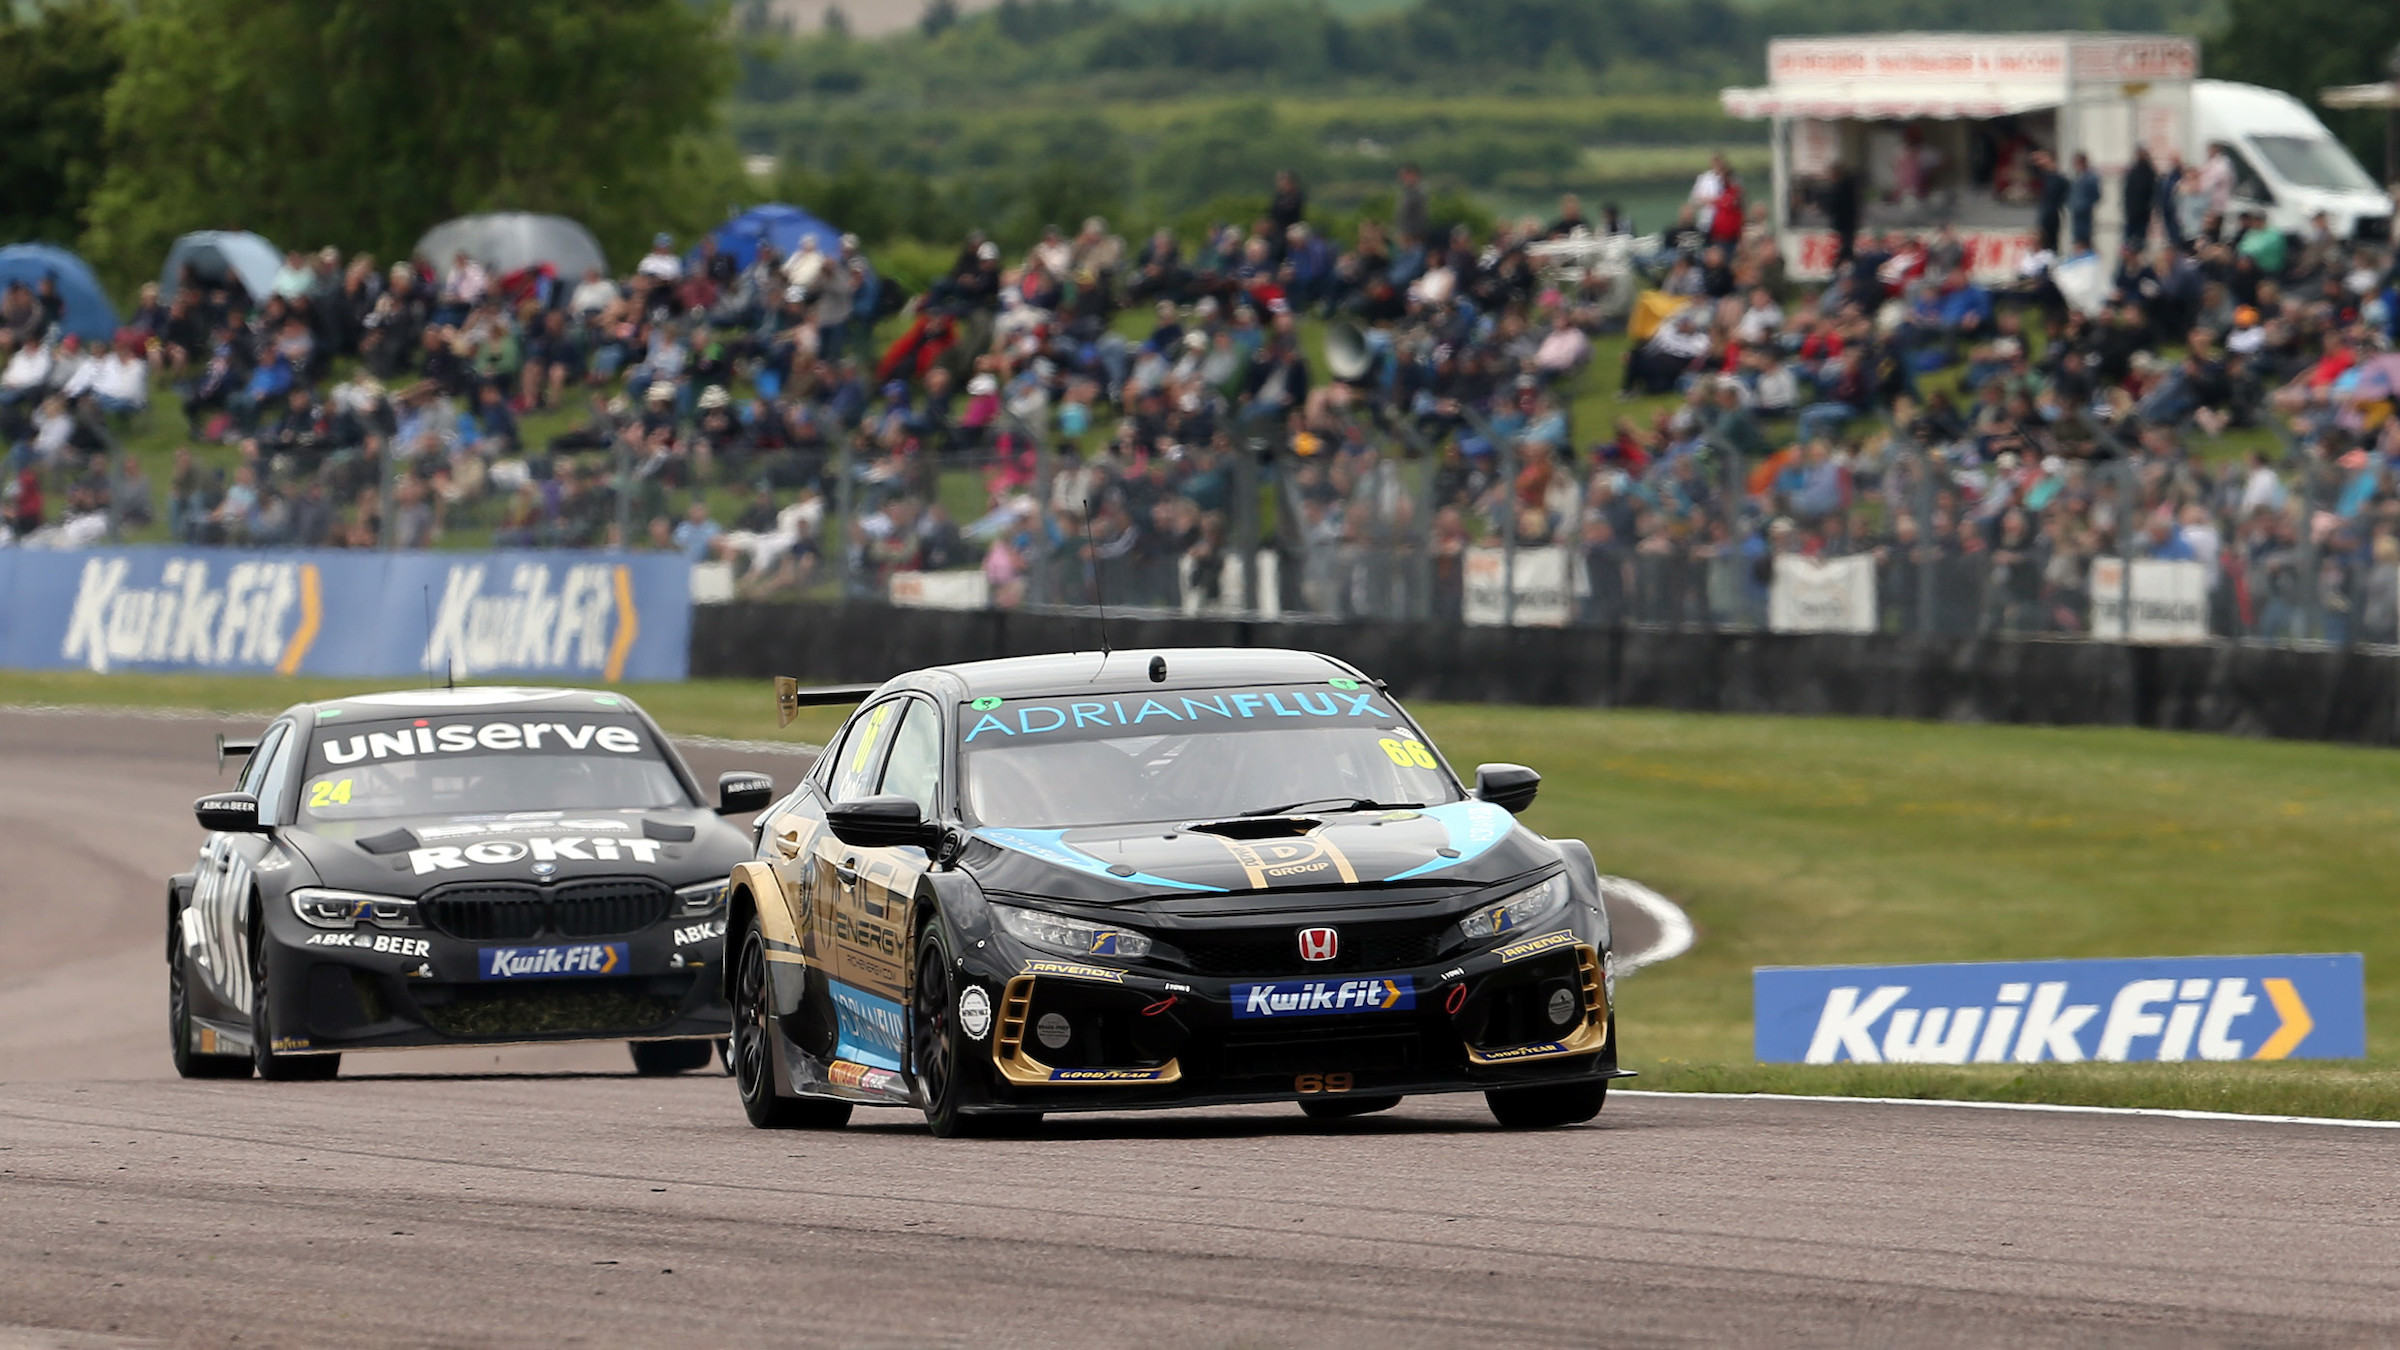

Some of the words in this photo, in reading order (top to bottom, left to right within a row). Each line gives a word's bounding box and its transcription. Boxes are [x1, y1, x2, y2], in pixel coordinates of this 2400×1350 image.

[63, 557, 300, 674] KwikFit
[1378, 738, 1437, 769] 66
[309, 778, 352, 808] 24
[202, 801, 222, 810] ABK
[230, 801, 255, 812] BEER
[1268, 862, 1330, 877] GROUP
[305, 933, 355, 946] ABK
[373, 935, 431, 958] BEER
[673, 921, 718, 947] ABK
[1504, 933, 1572, 958] RAVENOL
[491, 949, 604, 977] KwikFit
[1032, 963, 1116, 978] RAVENOL
[1246, 981, 1383, 1016] KwikFit
[1804, 978, 2257, 1064] KwikFit
[1295, 1073, 1353, 1093] 69
